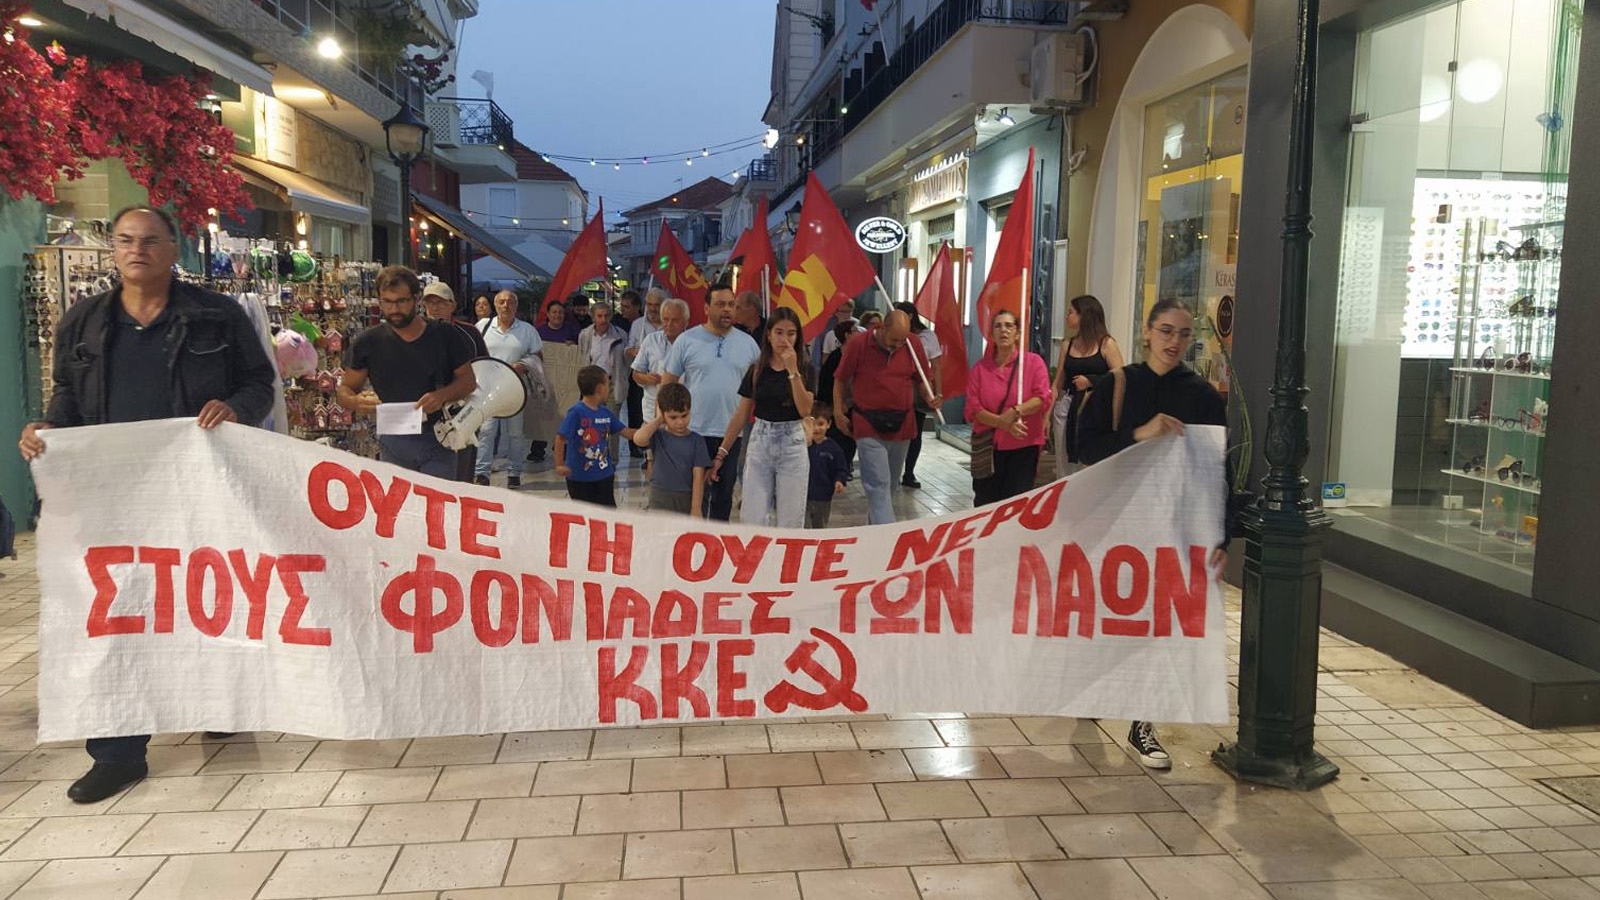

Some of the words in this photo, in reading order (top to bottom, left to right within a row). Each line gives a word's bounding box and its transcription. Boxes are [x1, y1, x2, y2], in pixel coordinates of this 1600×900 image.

[307, 460, 505, 559] ΟΥΤΕ
[549, 512, 634, 576] ΓΗ
[672, 531, 859, 584] ΟΥΤΕ
[886, 480, 1068, 571] ΝΕΡΟ
[83, 545, 333, 647] ΣΤΟΥΣ
[380, 553, 793, 654] ΦΟΝΙΑΔΕΣ
[833, 548, 974, 635] ΤΩΝ
[1012, 543, 1208, 638] ΛΑΩΝ
[596, 635, 758, 724] ΚΚΕ
